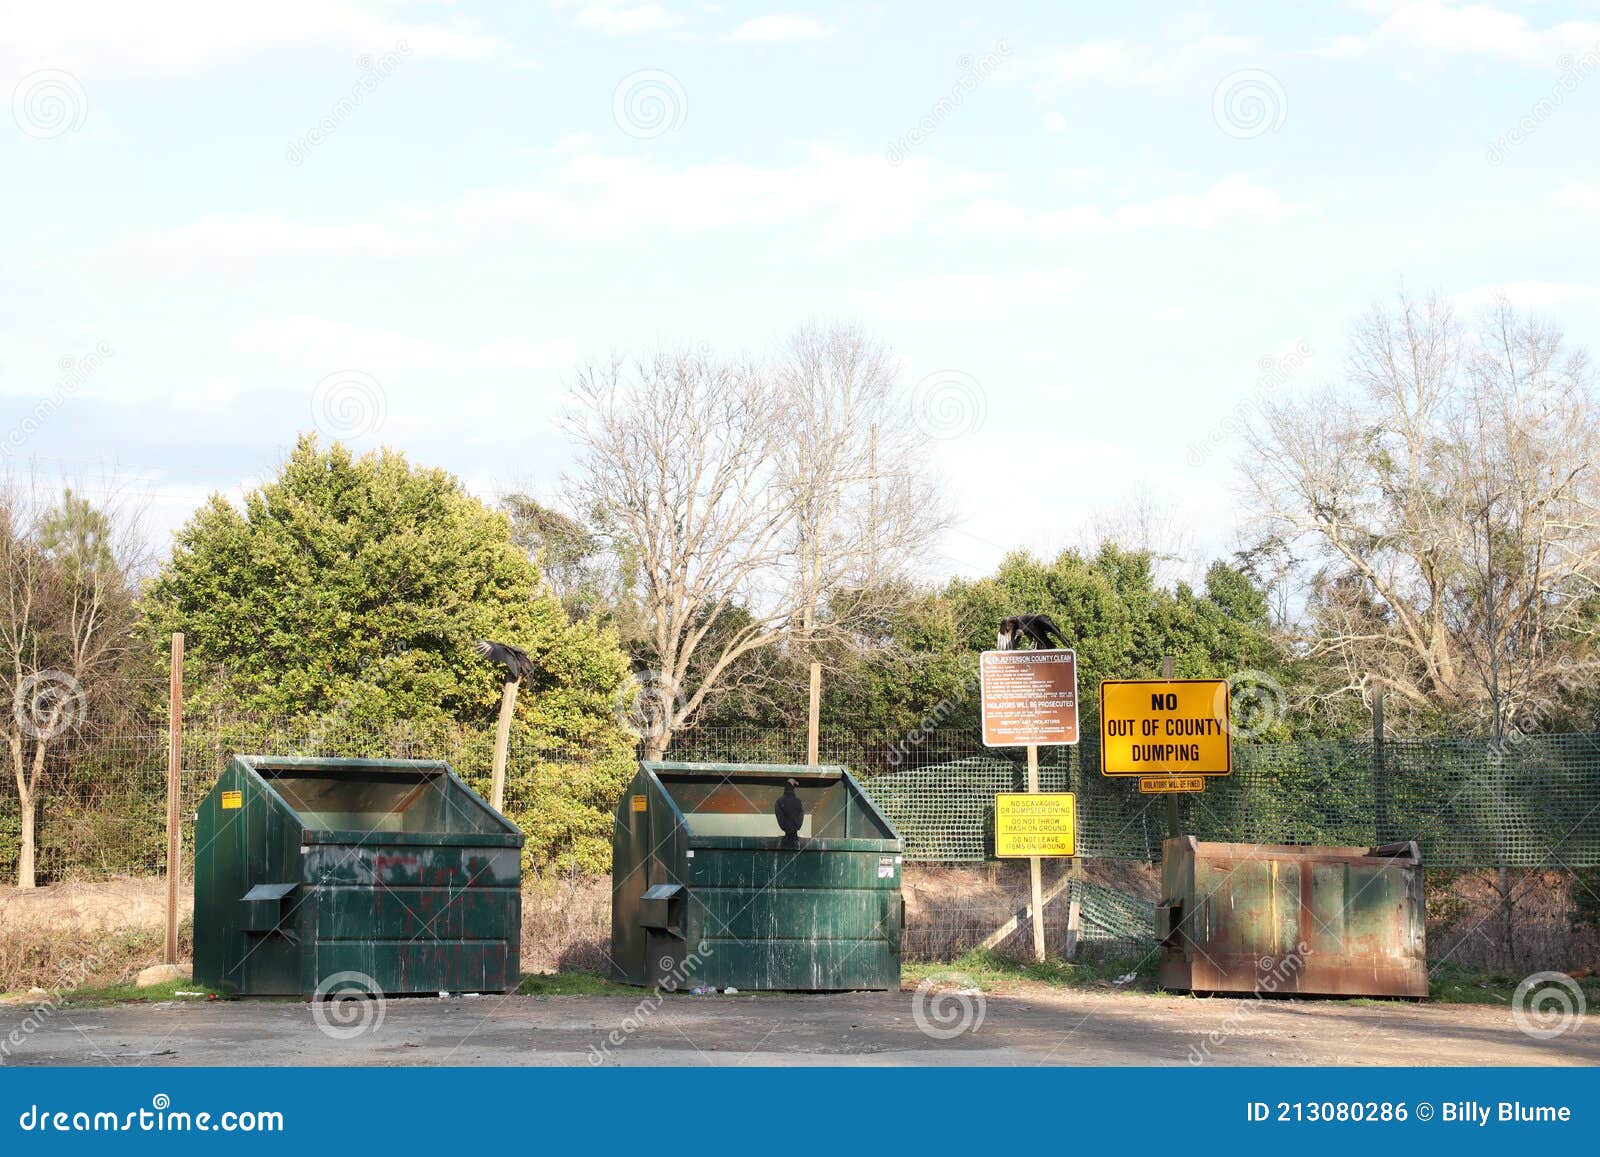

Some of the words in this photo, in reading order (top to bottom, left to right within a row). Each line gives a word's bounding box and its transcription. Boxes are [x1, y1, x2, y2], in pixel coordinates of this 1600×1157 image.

[1053, 654, 1072, 662] CLEAN
[1151, 693, 1178, 711] NO
[1108, 719, 1136, 736] OUT
[1142, 719, 1160, 736] OF
[1165, 718, 1223, 736] COUNTY
[1132, 744, 1200, 761] DUMPING
[1168, 780, 1179, 788] WILL
[1180, 780, 1186, 788] BE
